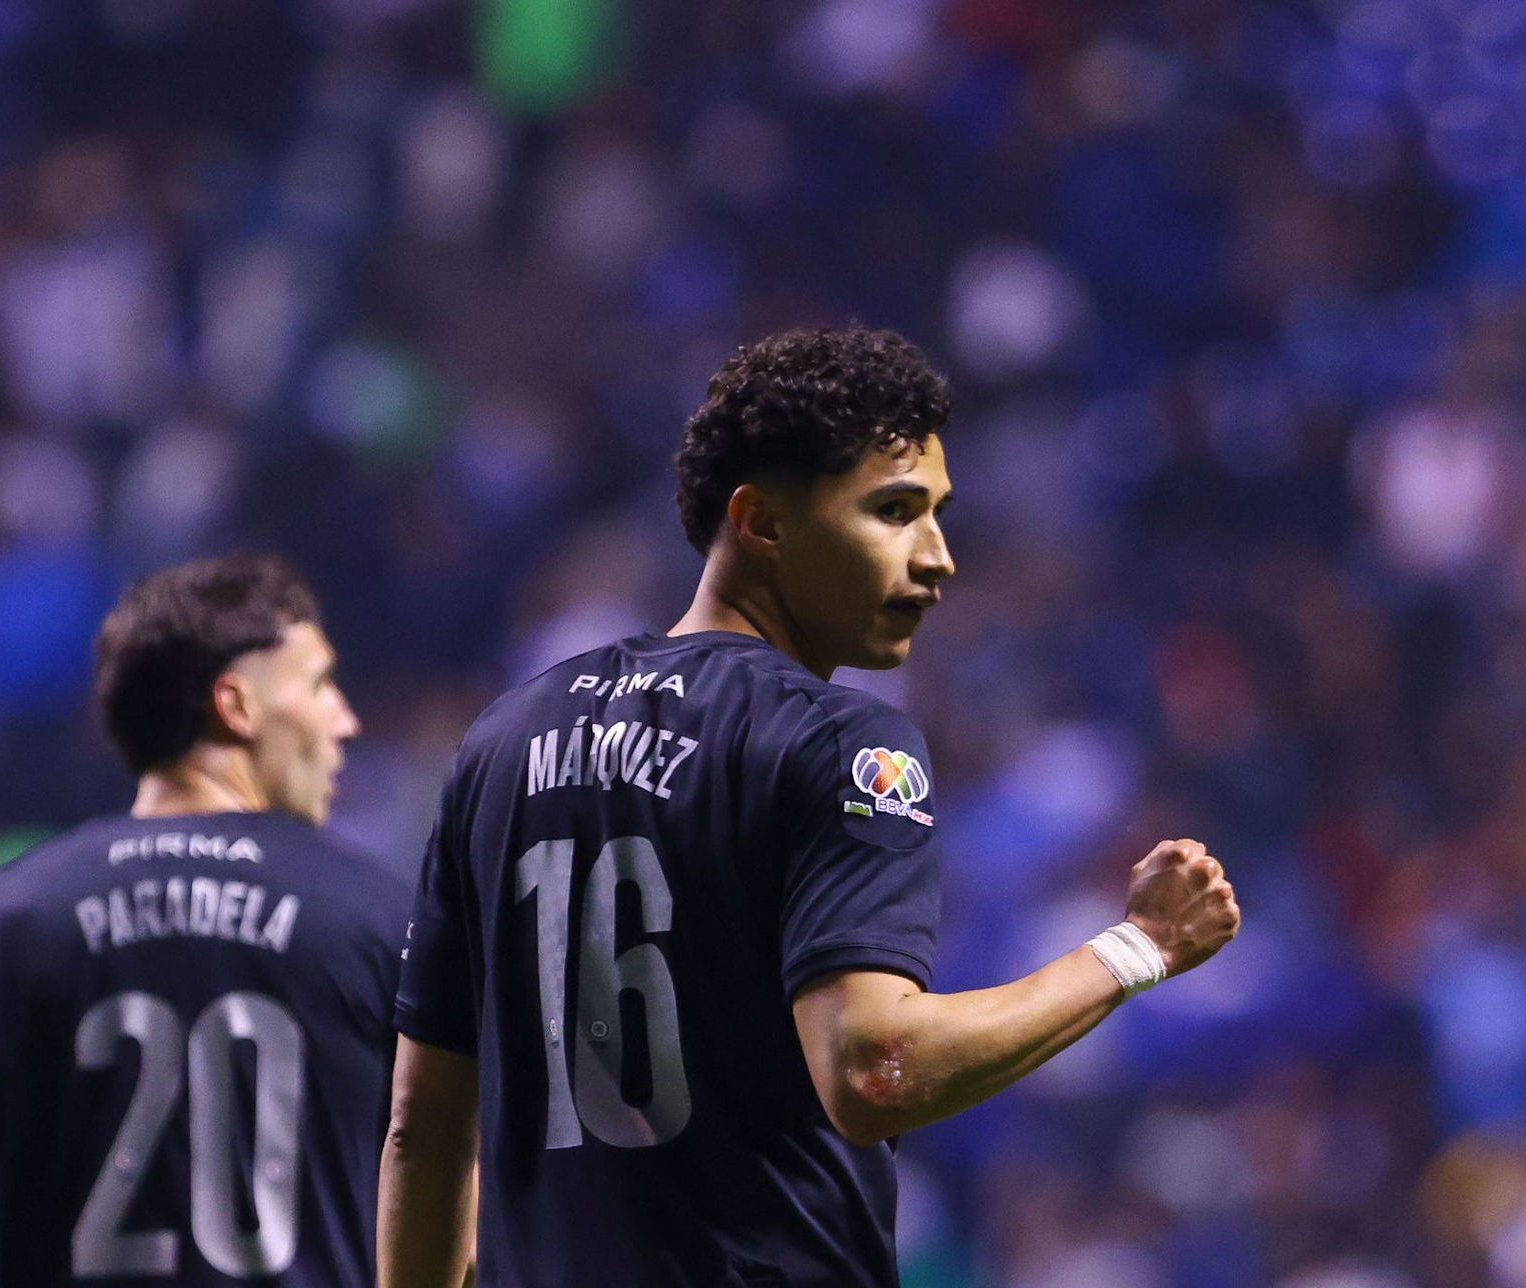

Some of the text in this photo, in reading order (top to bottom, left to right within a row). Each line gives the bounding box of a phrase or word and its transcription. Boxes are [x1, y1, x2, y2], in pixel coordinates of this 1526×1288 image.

[569, 671, 684, 702] PIRMA
[75, 876, 301, 954] PARADELA
[515, 835, 693, 1151] 16
[72, 989, 307, 1279] 20
